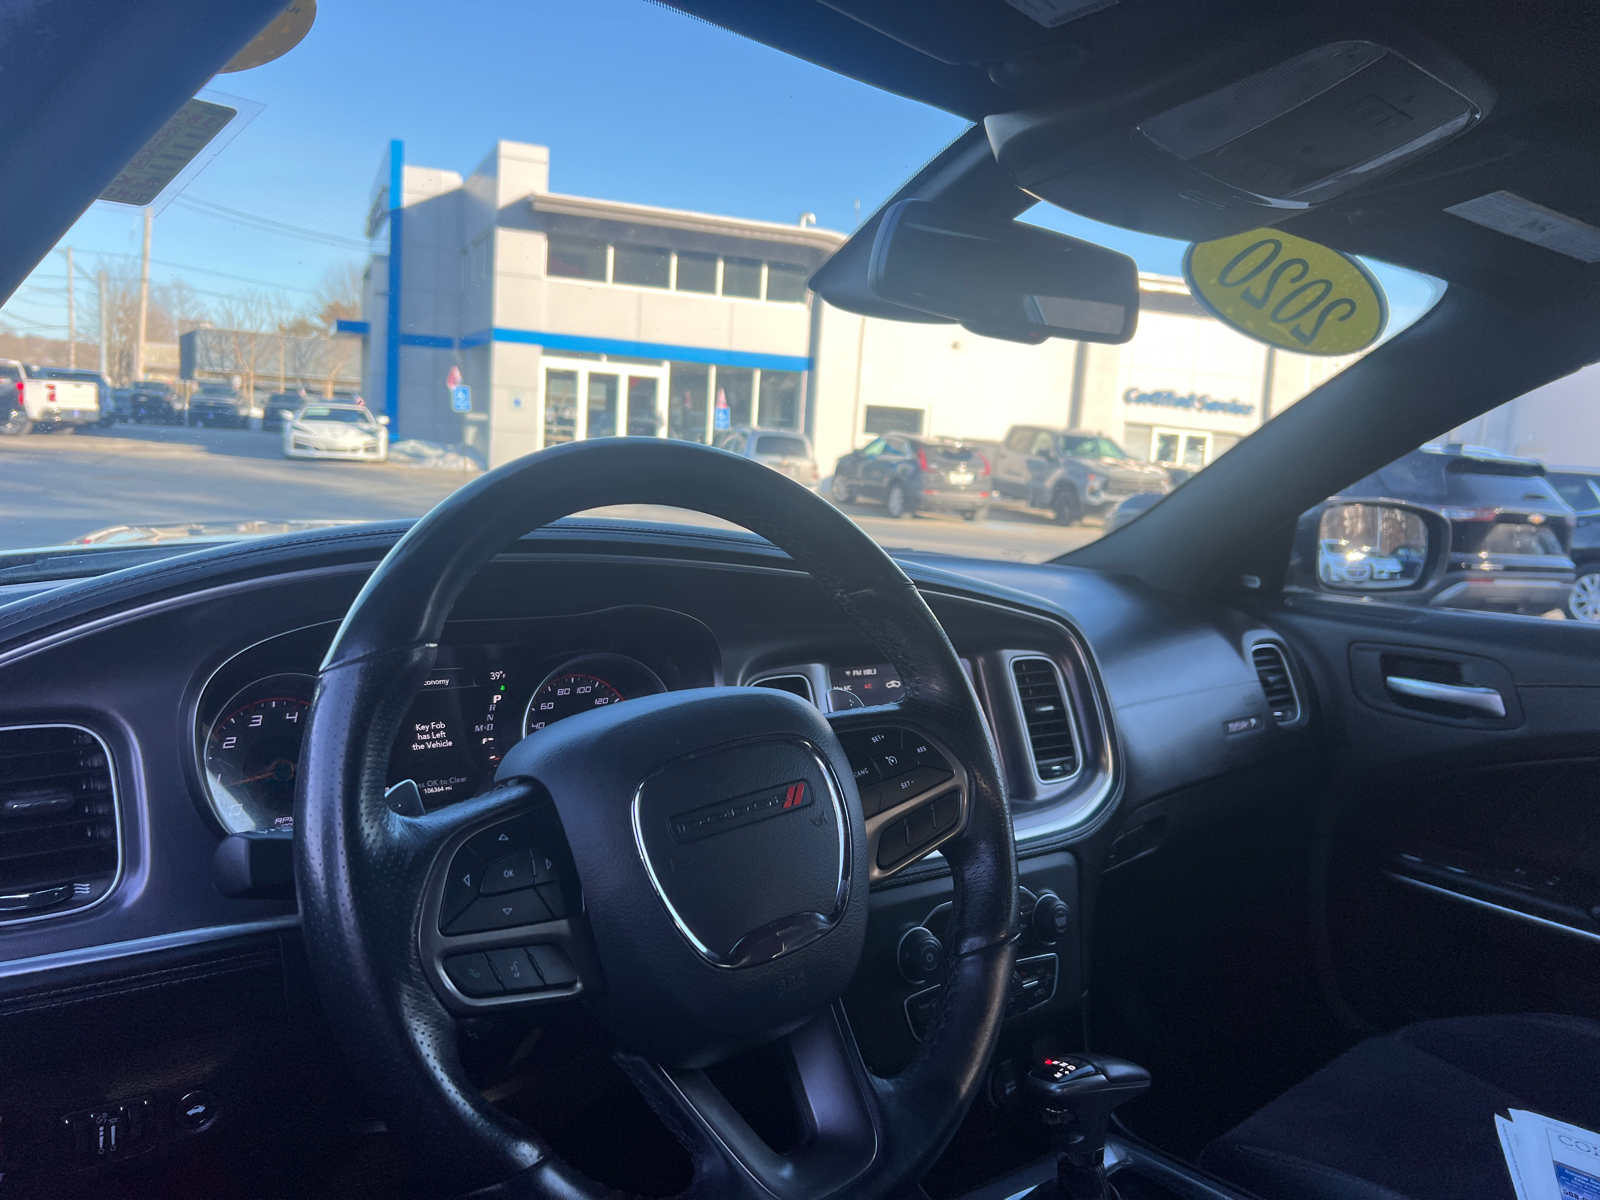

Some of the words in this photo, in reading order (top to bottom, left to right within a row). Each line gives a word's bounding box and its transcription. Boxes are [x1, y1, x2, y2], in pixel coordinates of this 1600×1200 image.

[576, 685, 592, 694] 100
[493, 694, 502, 704] P
[594, 697, 609, 705] 120
[489, 704, 496, 712] R
[540, 702, 554, 710] 60
[248, 714, 263, 727] 3
[285, 711, 299, 723] 4
[415, 723, 430, 732] Key
[431, 721, 446, 729] Fob
[531, 722, 545, 730] 40
[417, 733, 431, 741] has
[432, 731, 447, 739] Left
[222, 736, 237, 749] 2
[412, 743, 425, 751] the
[426, 740, 453, 749] Vehicle
[916, 745, 927, 754] RES
[853, 767, 869, 778] CANC
[427, 779, 439, 787] OK
[449, 776, 468, 784] Clear
[445, 784, 453, 792] mi
[503, 869, 515, 878] OK
